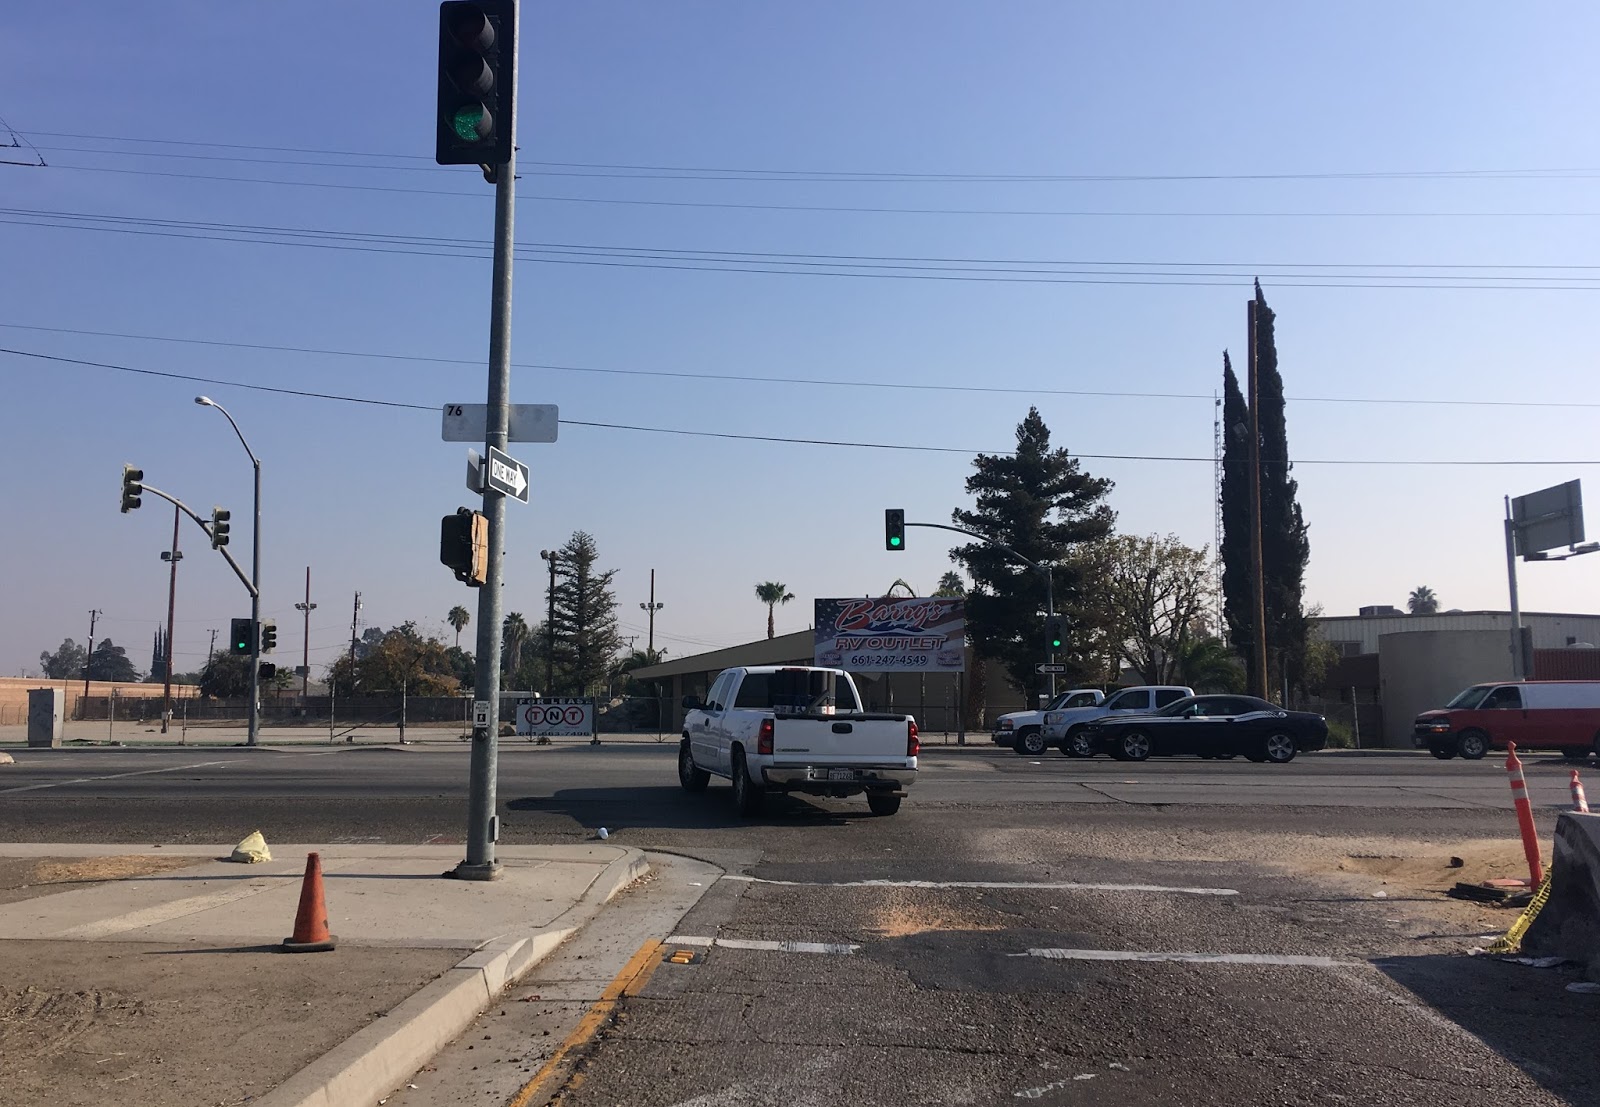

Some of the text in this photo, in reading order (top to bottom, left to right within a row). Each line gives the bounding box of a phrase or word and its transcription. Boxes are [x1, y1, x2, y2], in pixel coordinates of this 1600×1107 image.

[447, 405, 463, 416] 76
[493, 461, 517, 487] ONE WAY
[835, 598, 944, 632] Barry's
[835, 636, 947, 651] RV OUTLET
[851, 655, 928, 666] 661-247-4549
